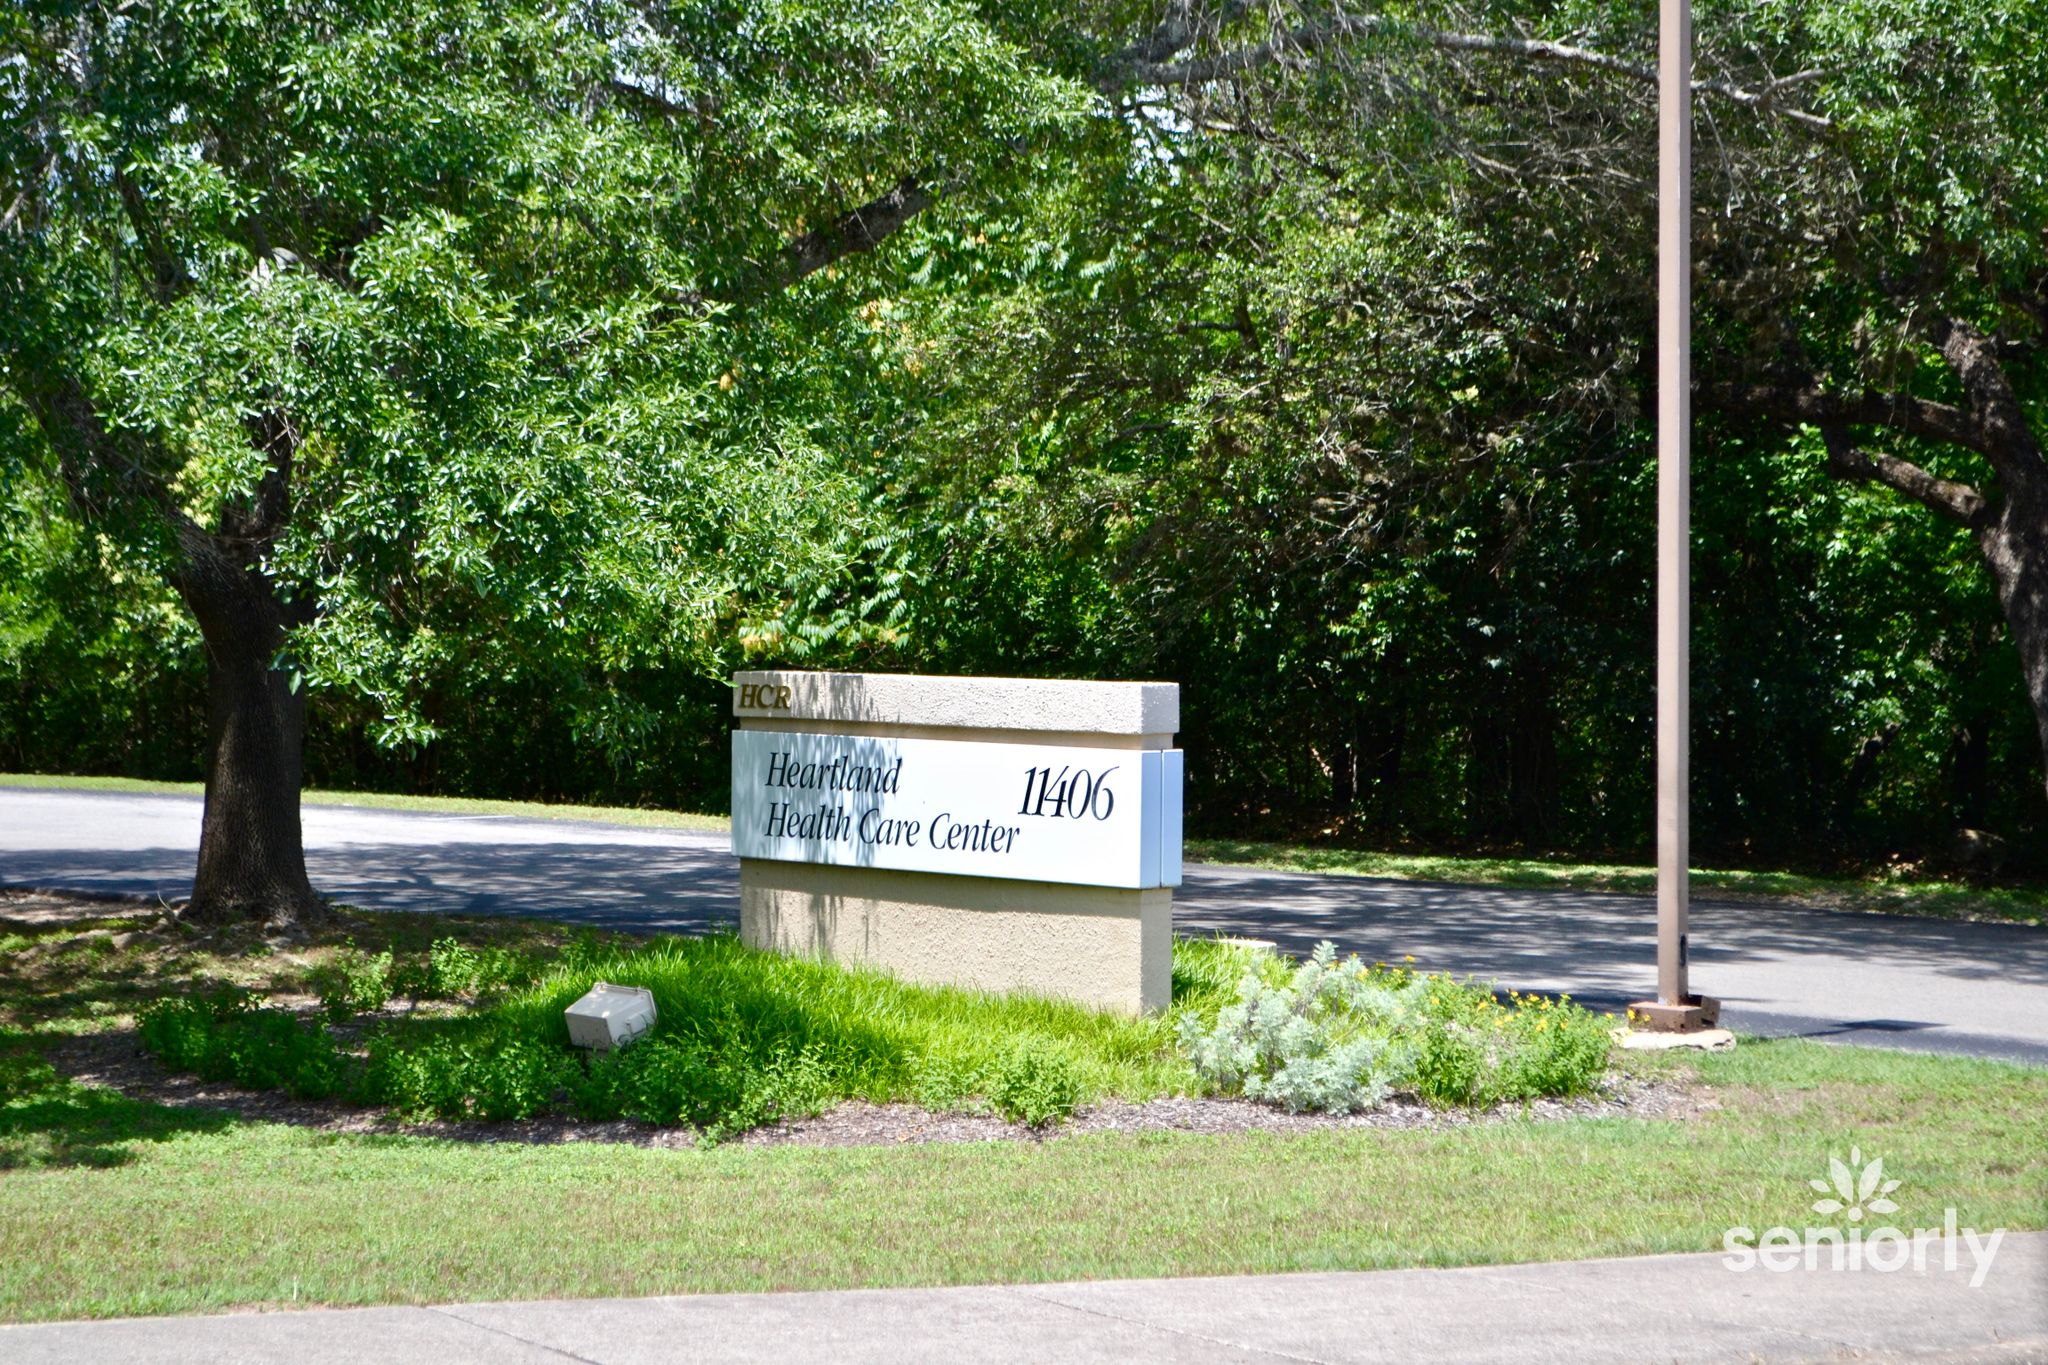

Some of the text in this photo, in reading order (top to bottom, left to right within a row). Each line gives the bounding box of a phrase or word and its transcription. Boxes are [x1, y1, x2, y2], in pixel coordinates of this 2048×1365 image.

[738, 683, 792, 710] HCR
[764, 751, 903, 795] Heartland
[1017, 765, 1120, 821] 11406
[764, 802, 1020, 854] Health Care Center
